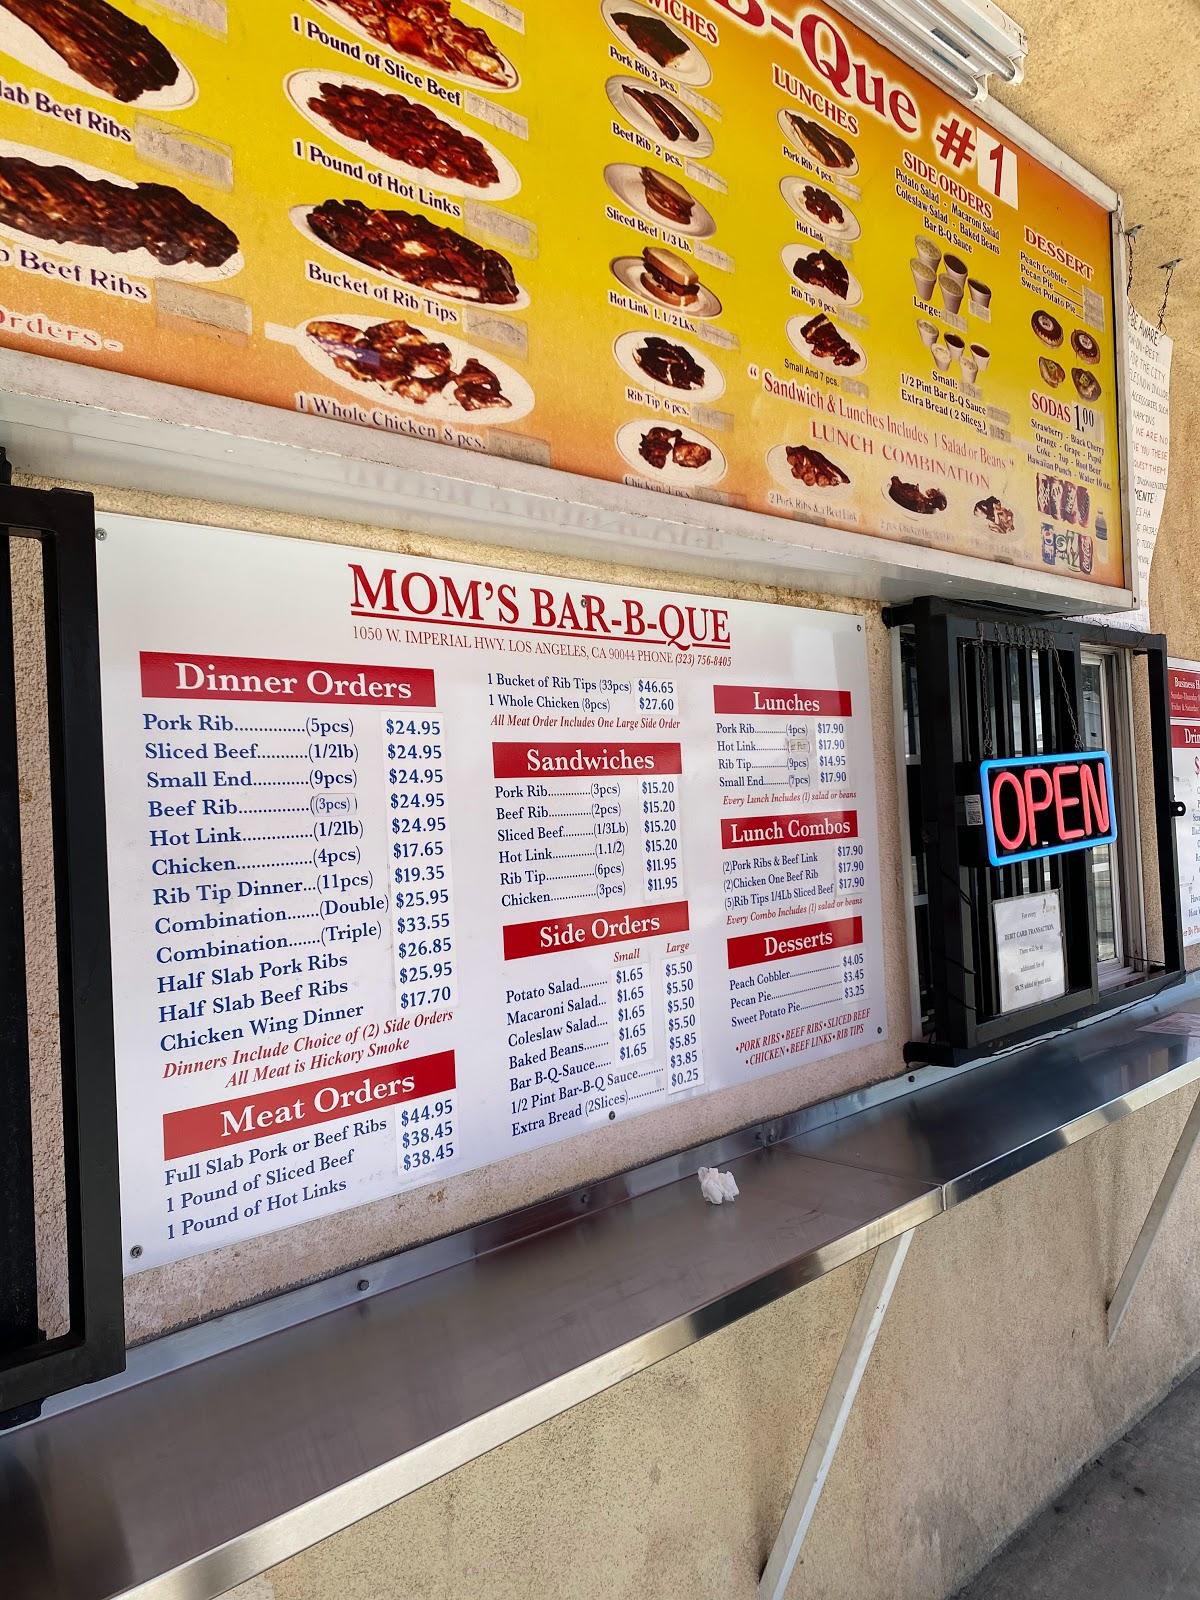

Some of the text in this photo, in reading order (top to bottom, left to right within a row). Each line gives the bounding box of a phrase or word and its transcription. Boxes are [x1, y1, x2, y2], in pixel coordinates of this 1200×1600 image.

[292, 16, 461, 107] 1 Pound of Slice Beef
[610, 46, 678, 94] Pork Rib 3 pcs.
[36, 91, 132, 143] Beef Ribs
[774, 66, 858, 134] LUNCHES
[904, 152, 992, 218] SIDE ORDERS
[796, 221, 824, 242] Hot Link
[896, 185, 999, 254] Coleslaw Salad Baked Beans
[1025, 227, 1093, 280] DESSERT
[309, 264, 458, 324] Bucket of Rib Tips
[1021, 264, 1053, 289] Pecan Pie
[791, 286, 837, 314] Rib Tip 9 pcs.
[1140, 321, 1159, 346] AWARE
[932, 371, 958, 389] Small:
[764, 373, 824, 410] Sandwich
[827, 396, 835, 413] &
[840, 404, 884, 430] Lunches
[887, 416, 928, 444] Includes
[942, 435, 967, 457] Salad
[968, 448, 977, 457] or
[980, 449, 1006, 469] Beans
[902, 389, 948, 416] Extra Bread
[1032, 393, 1070, 422] SODAS
[812, 421, 990, 490] LUNCH COMBINATION
[1031, 419, 1104, 456] Strawberry Black Cherry
[1146, 431, 1158, 442] ARE
[347, 564, 731, 650] MOM'S BAR-B-QUE
[352, 625, 732, 667] 1050 W. IMPERIAL HWY. LOS ANGELES, CA 90044 PHONE (323) 756-8405
[174, 663, 411, 699] Dinner Orders
[488, 673, 673, 694] 1 Bucket of Rib Tips (33pcs) $46.65
[1175, 677, 1195, 689] Business
[754, 691, 820, 711] Lunches
[527, 748, 654, 772] Sandwiches
[992, 762, 1110, 851] OPEN
[731, 818, 850, 843] Lunch Combos
[769, 874, 784, 884] One
[787, 871, 803, 882] Beef
[806, 869, 818, 880] Rib
[838, 861, 864, 873] $17.90
[727, 914, 749, 926] Every
[750, 907, 777, 922] Combo
[778, 904, 807, 916] Includes
[818, 900, 835, 911] salad
[845, 897, 863, 908] beans
[540, 915, 660, 948] Side Orders
[764, 931, 833, 957] Desserts
[1005, 932, 1015, 941] DEBIT
[1017, 929, 1027, 938] CARD
[157, 938, 452, 993] Half Slab Pork Ribs $26.85
[614, 943, 689, 963] Small Large
[158, 962, 452, 1023] Half Slab Beef Ribs $25.95
[161, 986, 451, 1052] Chicken Wing Dinner $17.70
[162, 1008, 453, 1079] Dinners Include Choice of (2) Side Orders
[226, 1037, 410, 1088] All Meat is Hickory Smoke
[221, 1072, 415, 1137] Meat Orders
[164, 1100, 453, 1186] Full Slab Pork or Beef Ribs $44.95
[167, 1122, 453, 1213] 1 Pound of Sliced Beef $38.45
